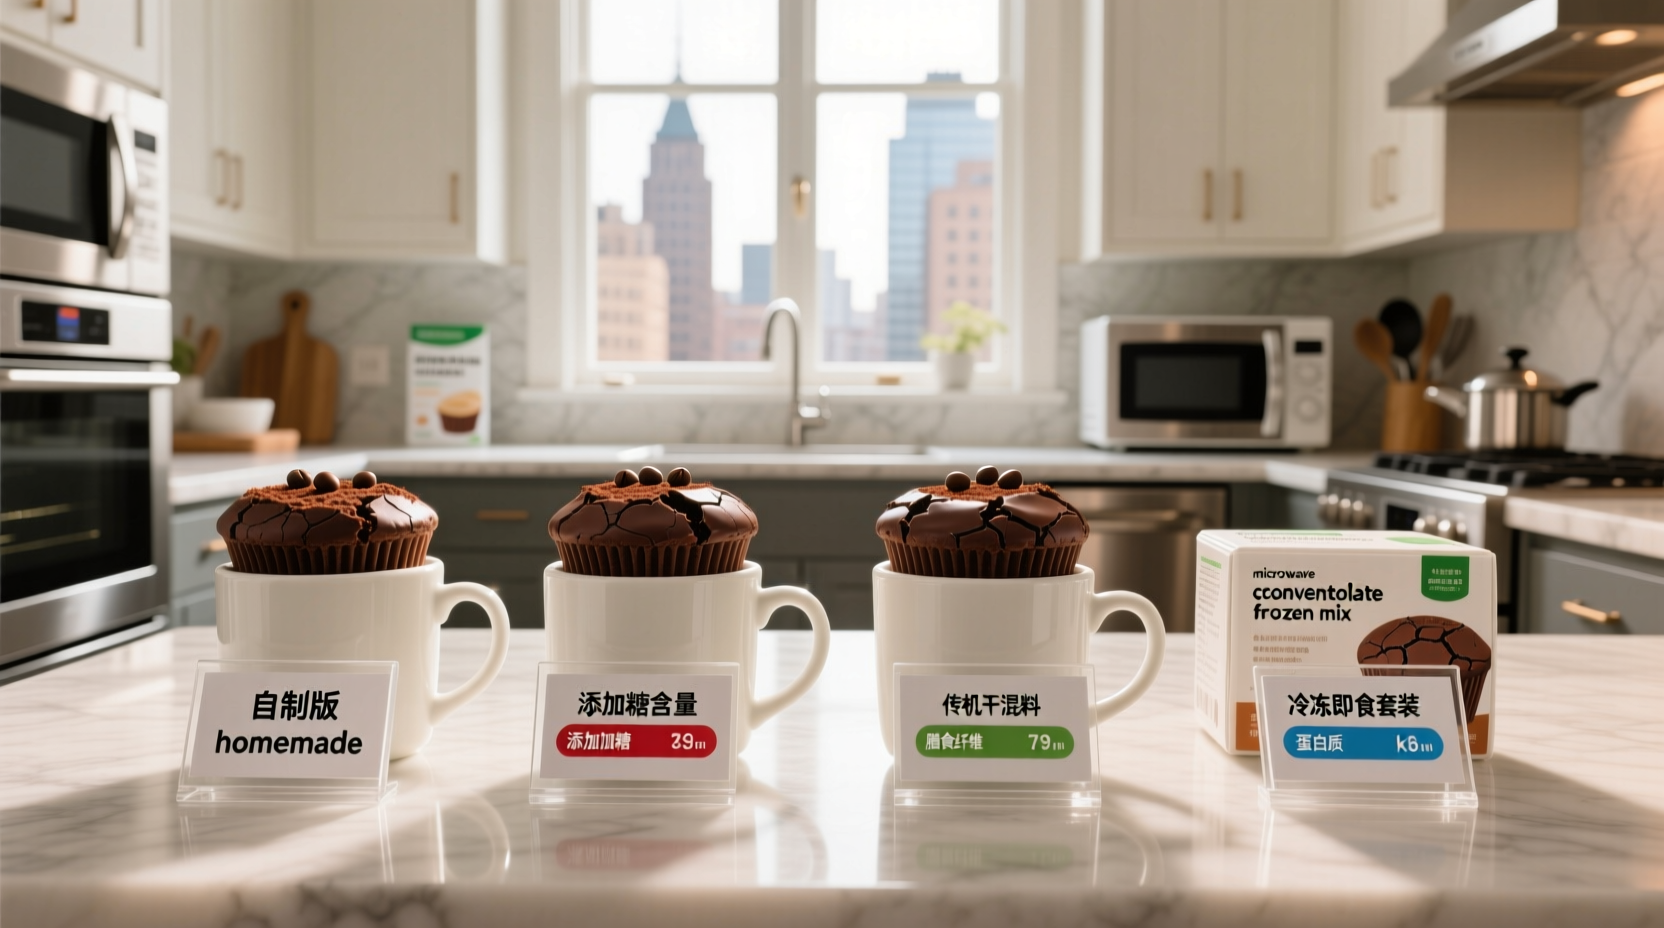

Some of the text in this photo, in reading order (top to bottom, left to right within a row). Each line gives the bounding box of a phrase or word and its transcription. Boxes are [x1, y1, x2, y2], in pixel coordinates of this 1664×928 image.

[1253, 567, 1315, 579] microwave
[1253, 582, 1383, 601] cconventolate
[1253, 603, 1351, 621] frozen mix
[253, 690, 340, 721] 自制版
[578, 691, 697, 717] 添加糖含量
[942, 693, 1041, 717] 传机干混料
[1287, 692, 1420, 718] 冷冻即食套装
[215, 729, 363, 754] homemade
[1296, 734, 1343, 752] 蛋白质
